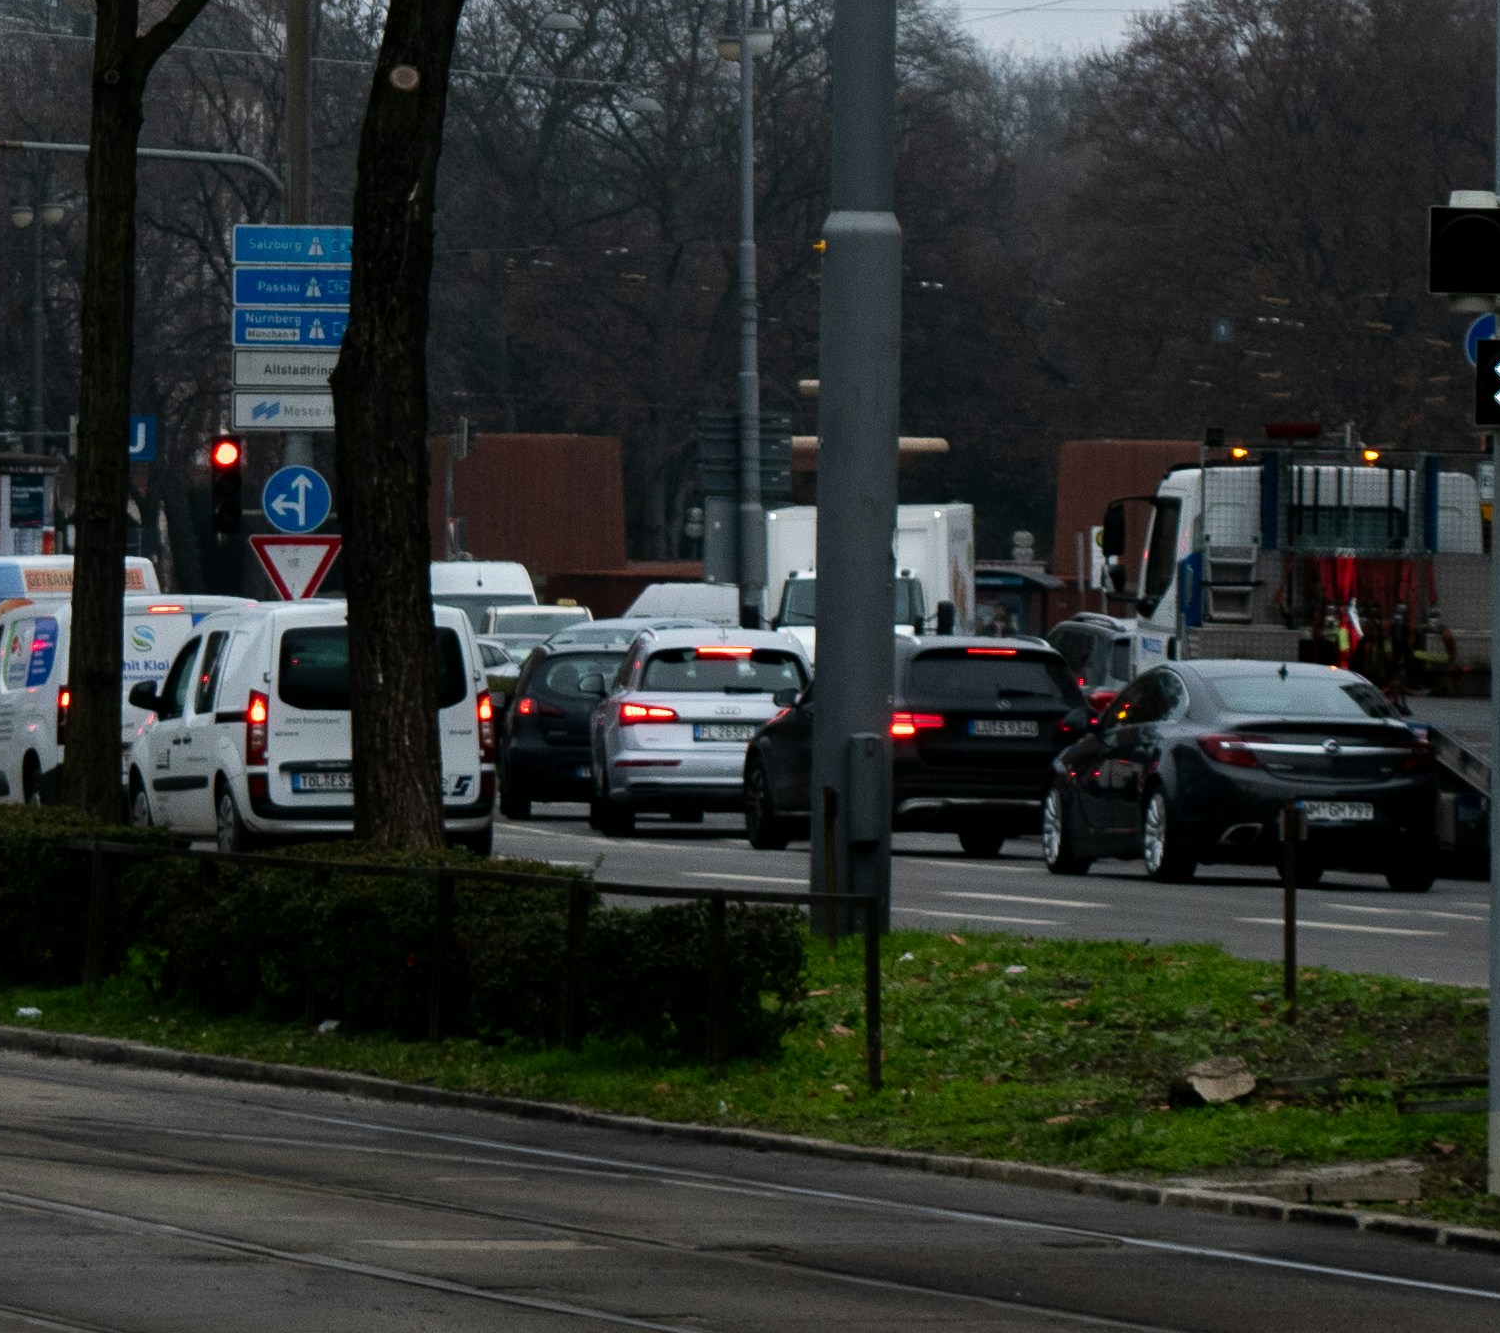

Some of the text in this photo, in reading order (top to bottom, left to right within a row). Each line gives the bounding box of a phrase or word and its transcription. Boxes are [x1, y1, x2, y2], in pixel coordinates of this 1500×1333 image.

[248, 237, 302, 252] Salzburg
[257, 280, 301, 293] Passau
[244, 312, 302, 328] Nürnberg
